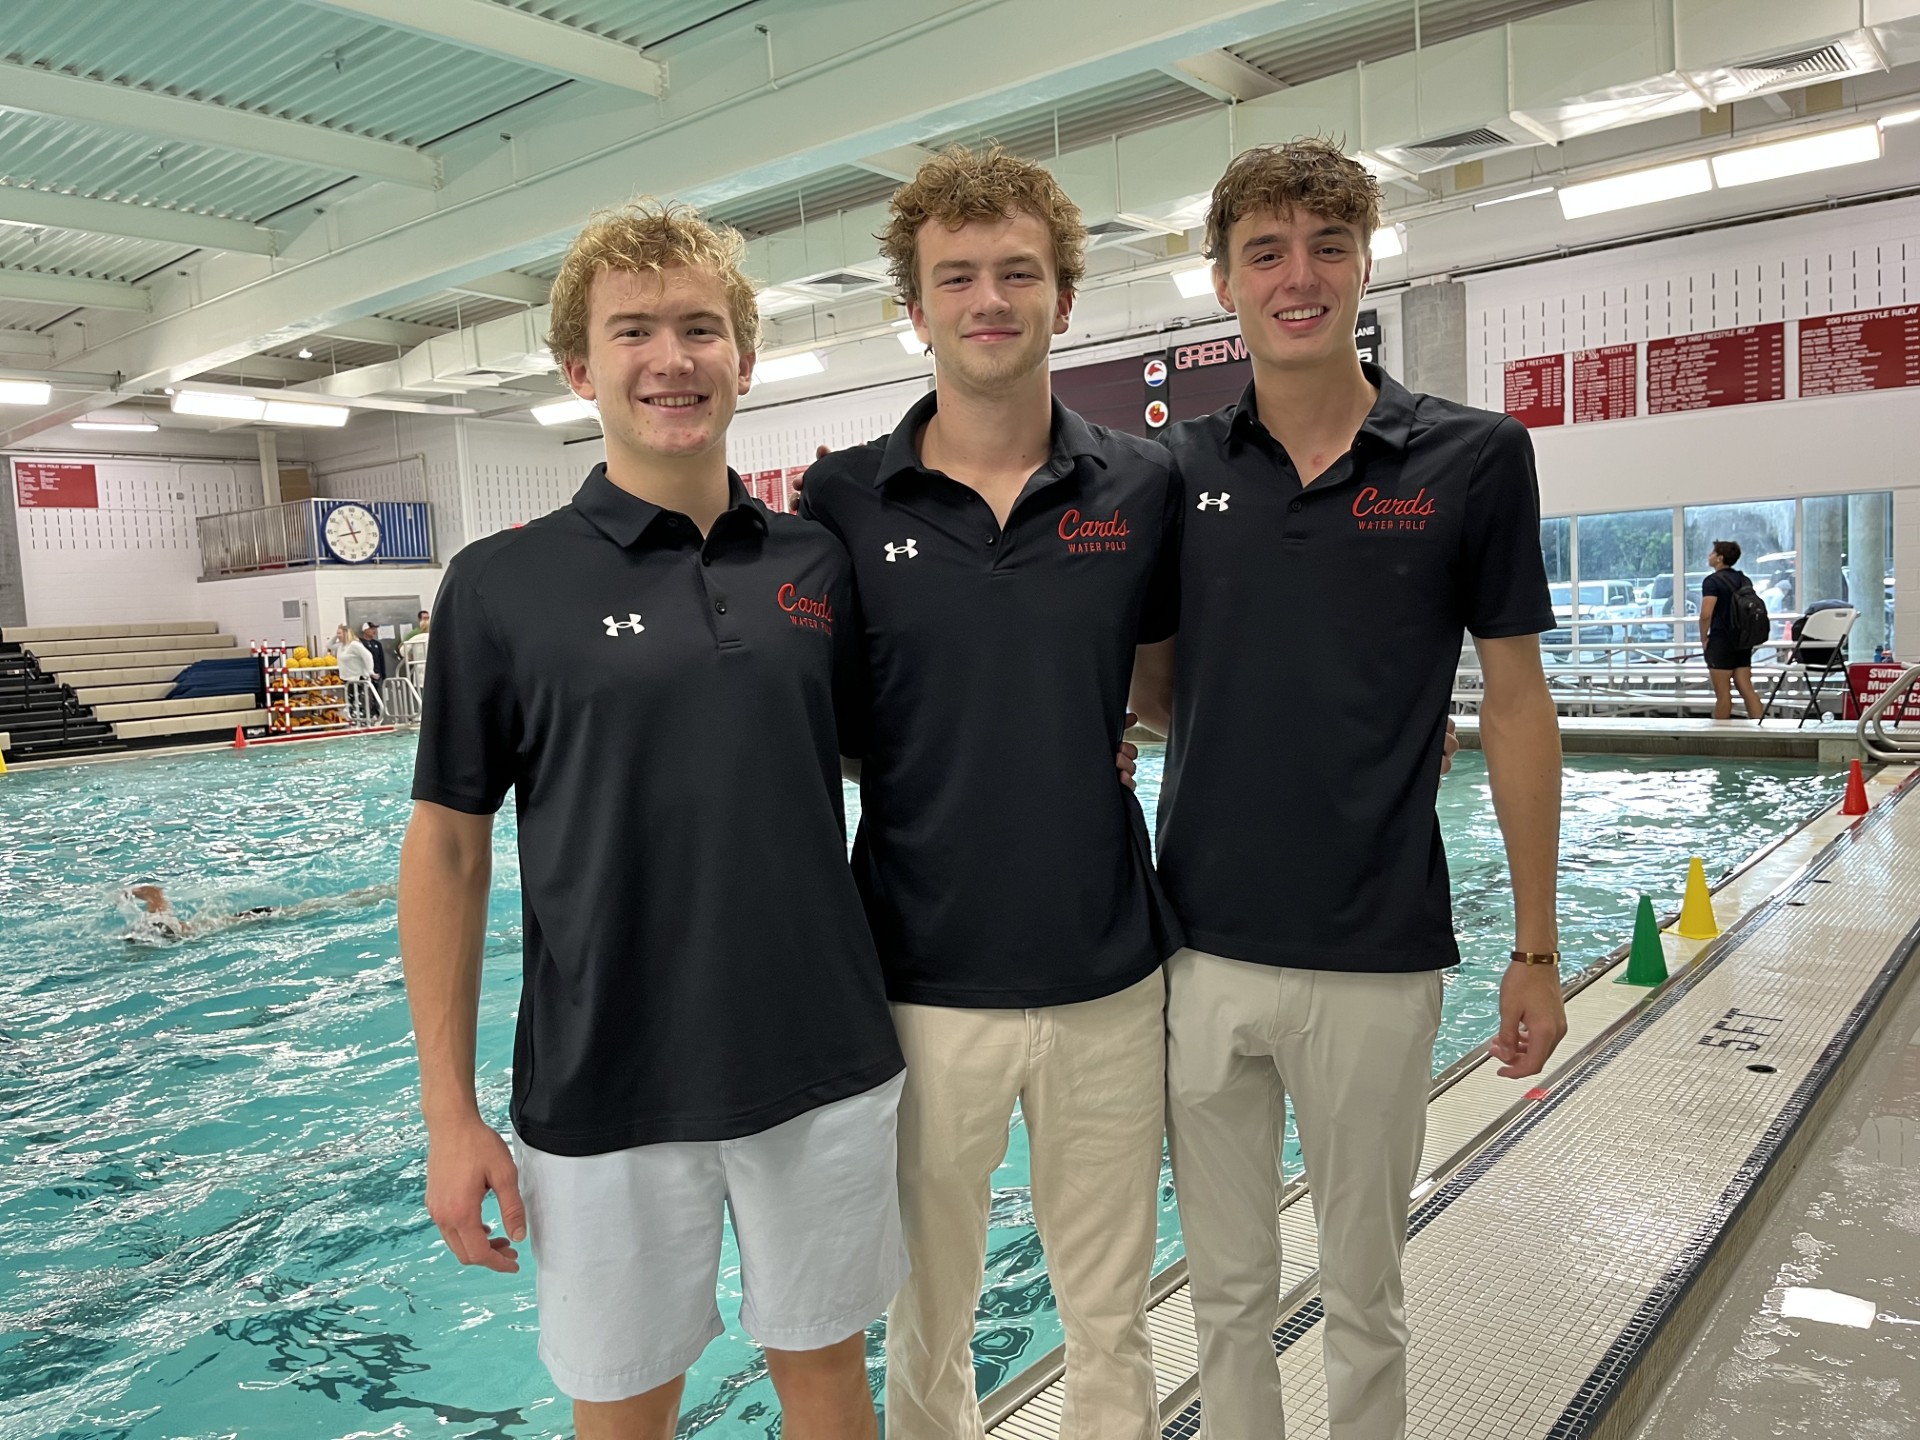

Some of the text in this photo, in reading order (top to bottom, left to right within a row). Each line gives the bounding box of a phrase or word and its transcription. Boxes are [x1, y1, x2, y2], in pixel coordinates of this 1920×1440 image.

[1842, 310, 1890, 323] FREESTYLE
[1891, 307, 1918, 317] RELAY
[1703, 330, 1735, 341] FREESTYLE
[1352, 486, 1436, 517] Cards
[1058, 508, 1131, 540] Cards
[1358, 520, 1426, 530] WATER POLO
[1067, 541, 1127, 553] WATER POLO
